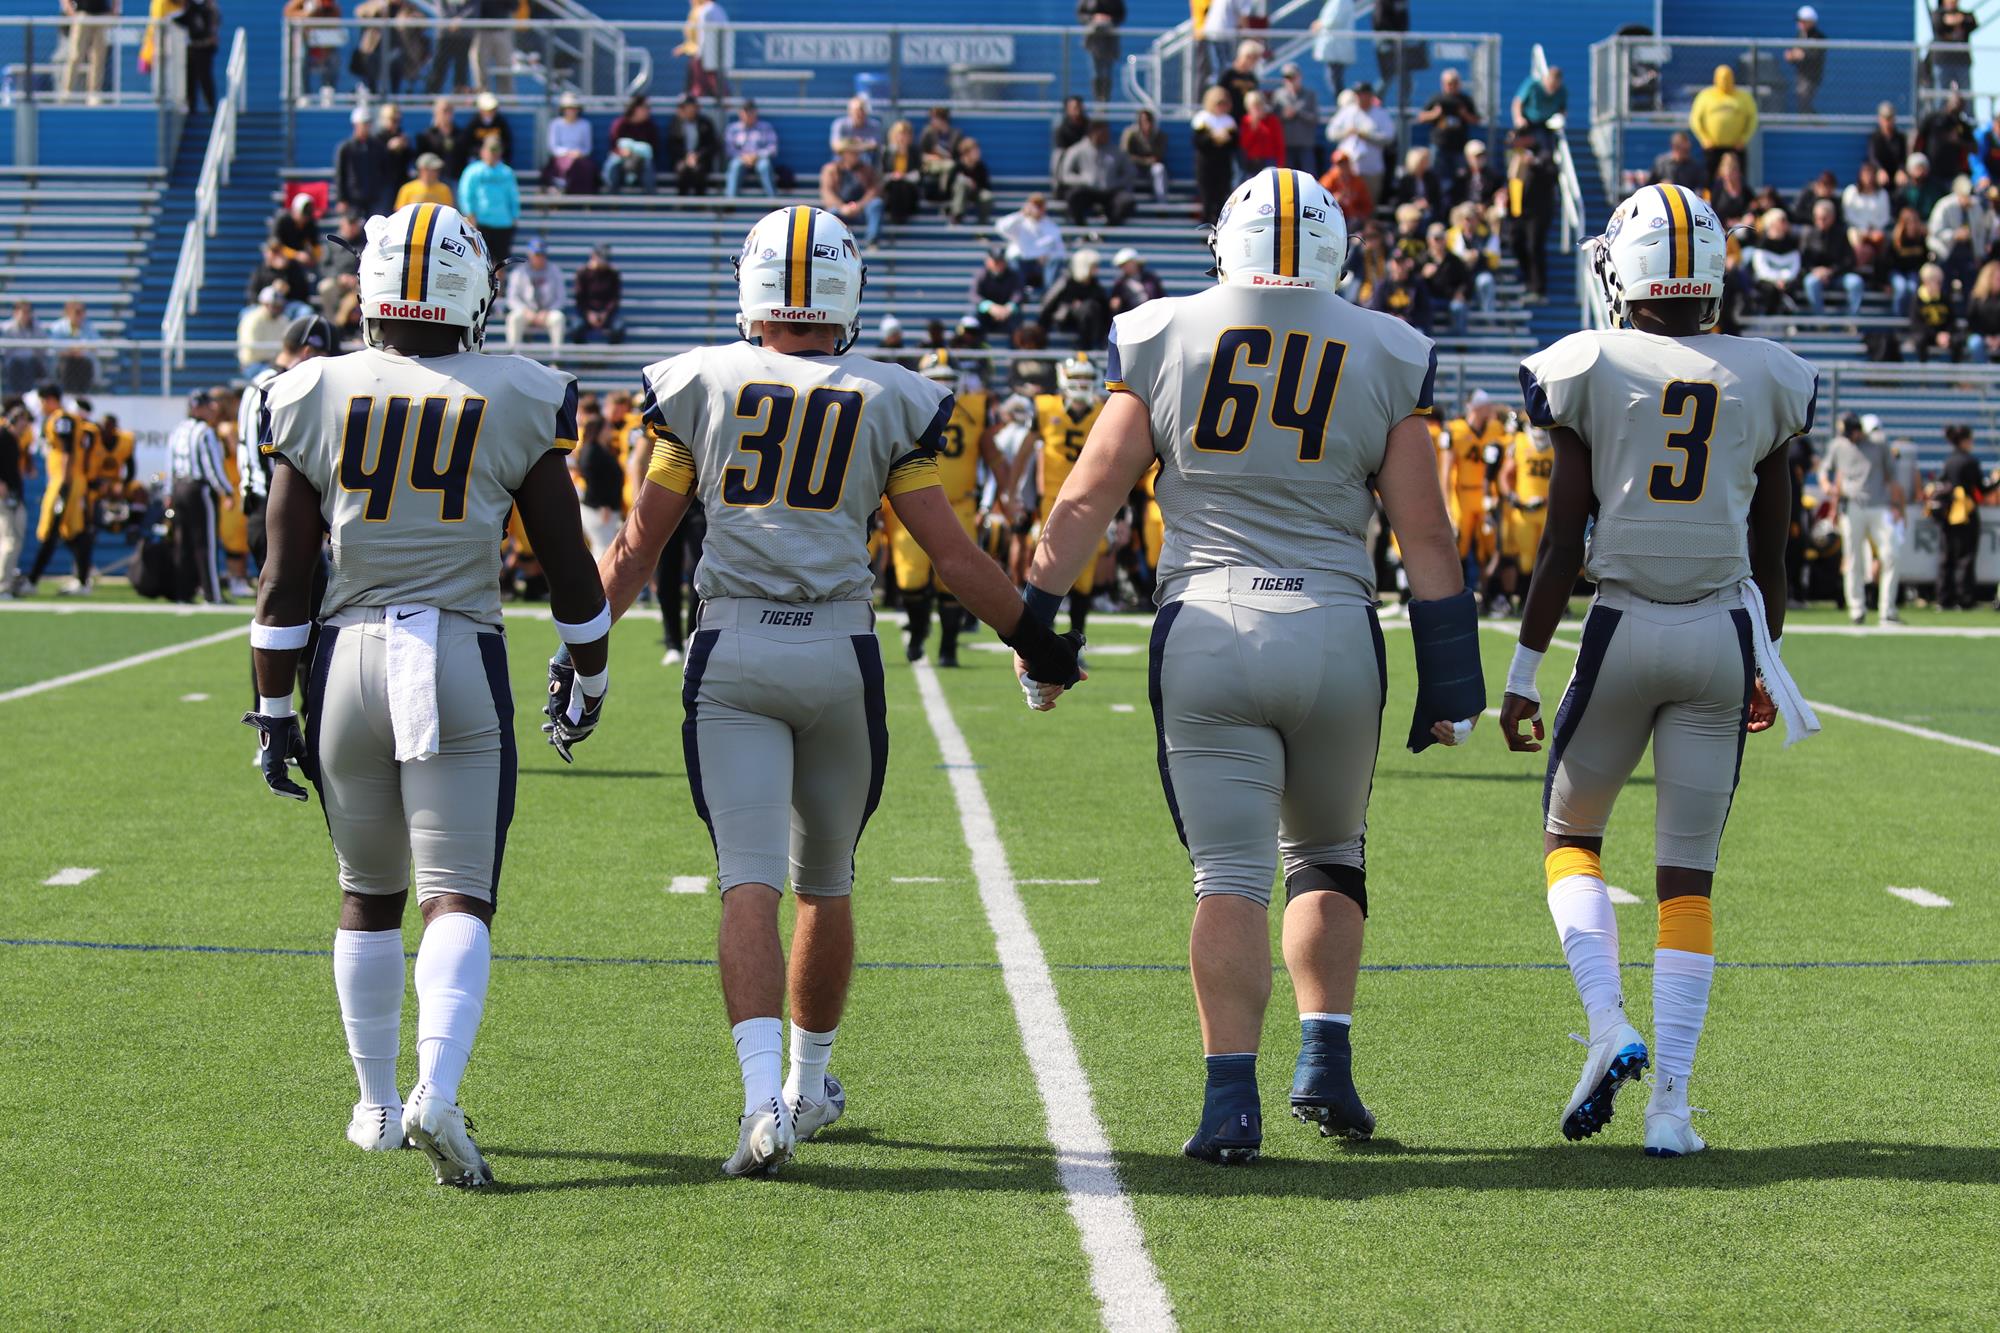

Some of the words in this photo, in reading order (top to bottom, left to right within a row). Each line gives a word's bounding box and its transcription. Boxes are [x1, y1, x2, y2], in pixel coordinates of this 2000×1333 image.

[770, 37, 891, 60] RESERVED
[906, 37, 1008, 61] SECTION
[1650, 283, 1711, 297] Riddell
[380, 303, 446, 321] Riddell
[771, 309, 826, 321] Riddell
[1192, 327, 1347, 463] 64
[722, 381, 864, 511] 30
[1648, 379, 1720, 503] 3
[339, 395, 487, 522] 44
[1251, 577, 1305, 592] TIGERS
[759, 610, 814, 627] TIGERS
